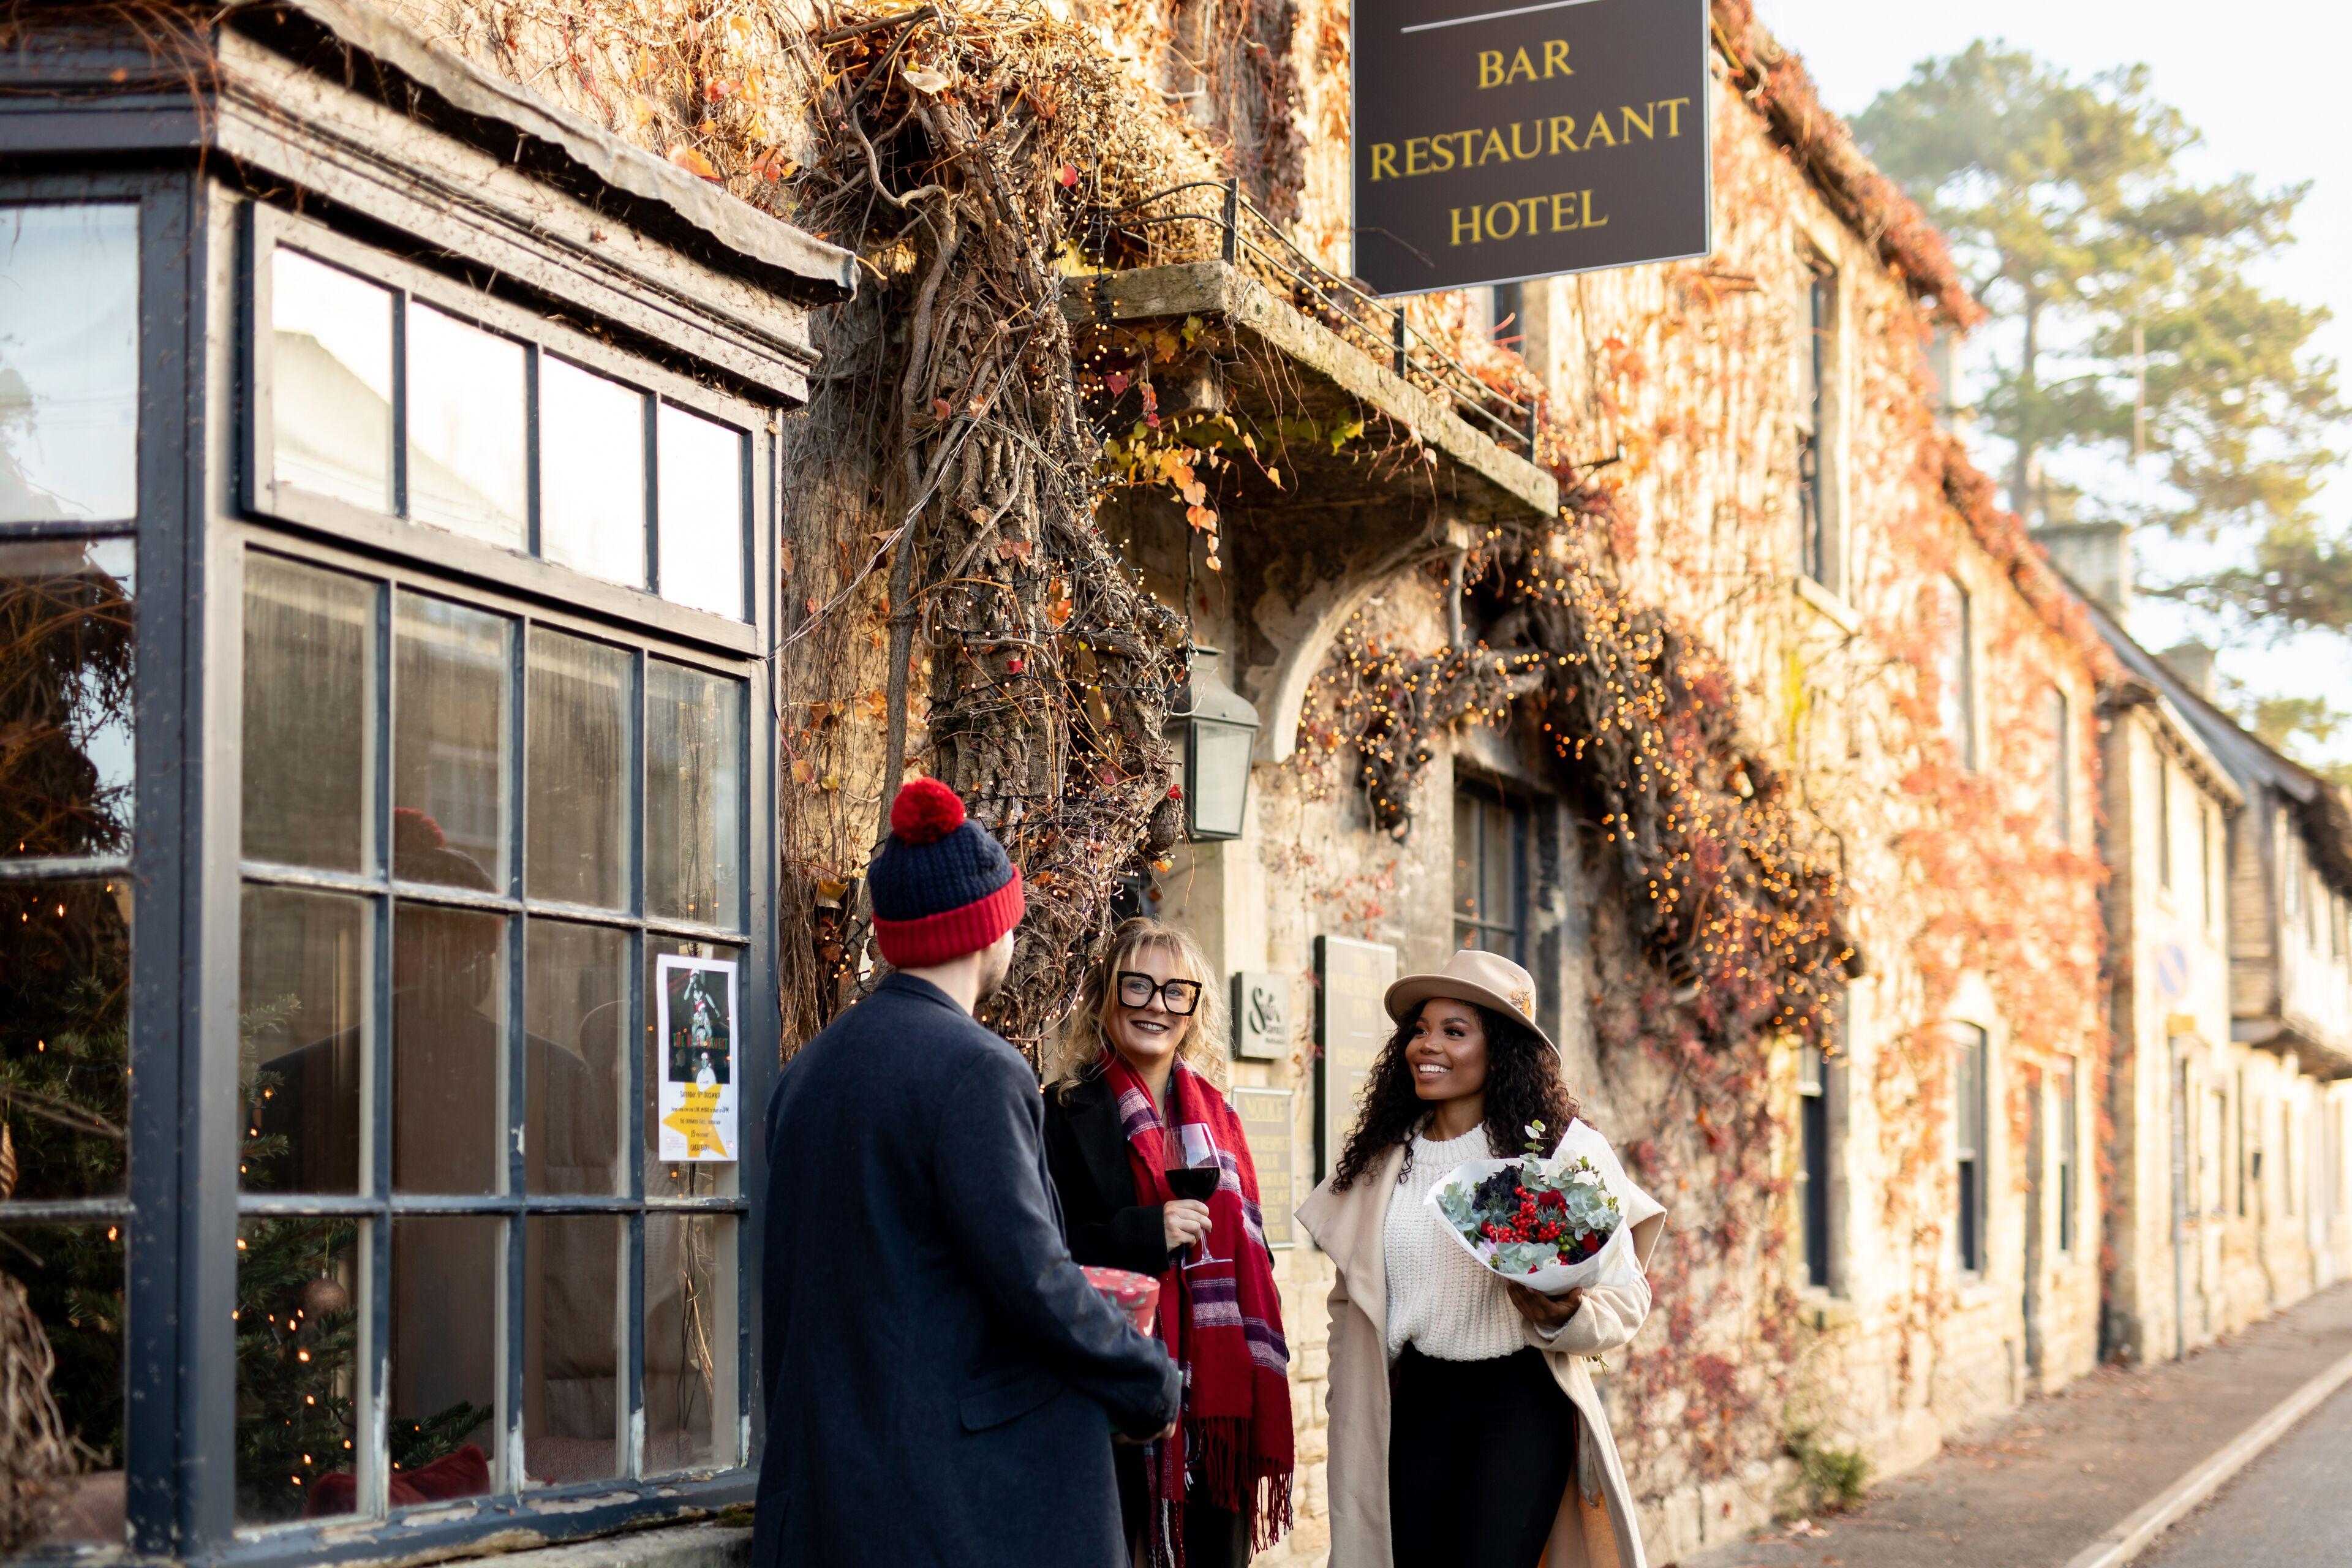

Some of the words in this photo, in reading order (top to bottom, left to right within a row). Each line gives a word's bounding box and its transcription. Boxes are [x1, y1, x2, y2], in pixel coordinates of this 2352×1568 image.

[1476, 39, 1574, 90] BAR
[1371, 97, 1690, 181] RESTAURANT
[1450, 189, 1608, 246] HOTEL
